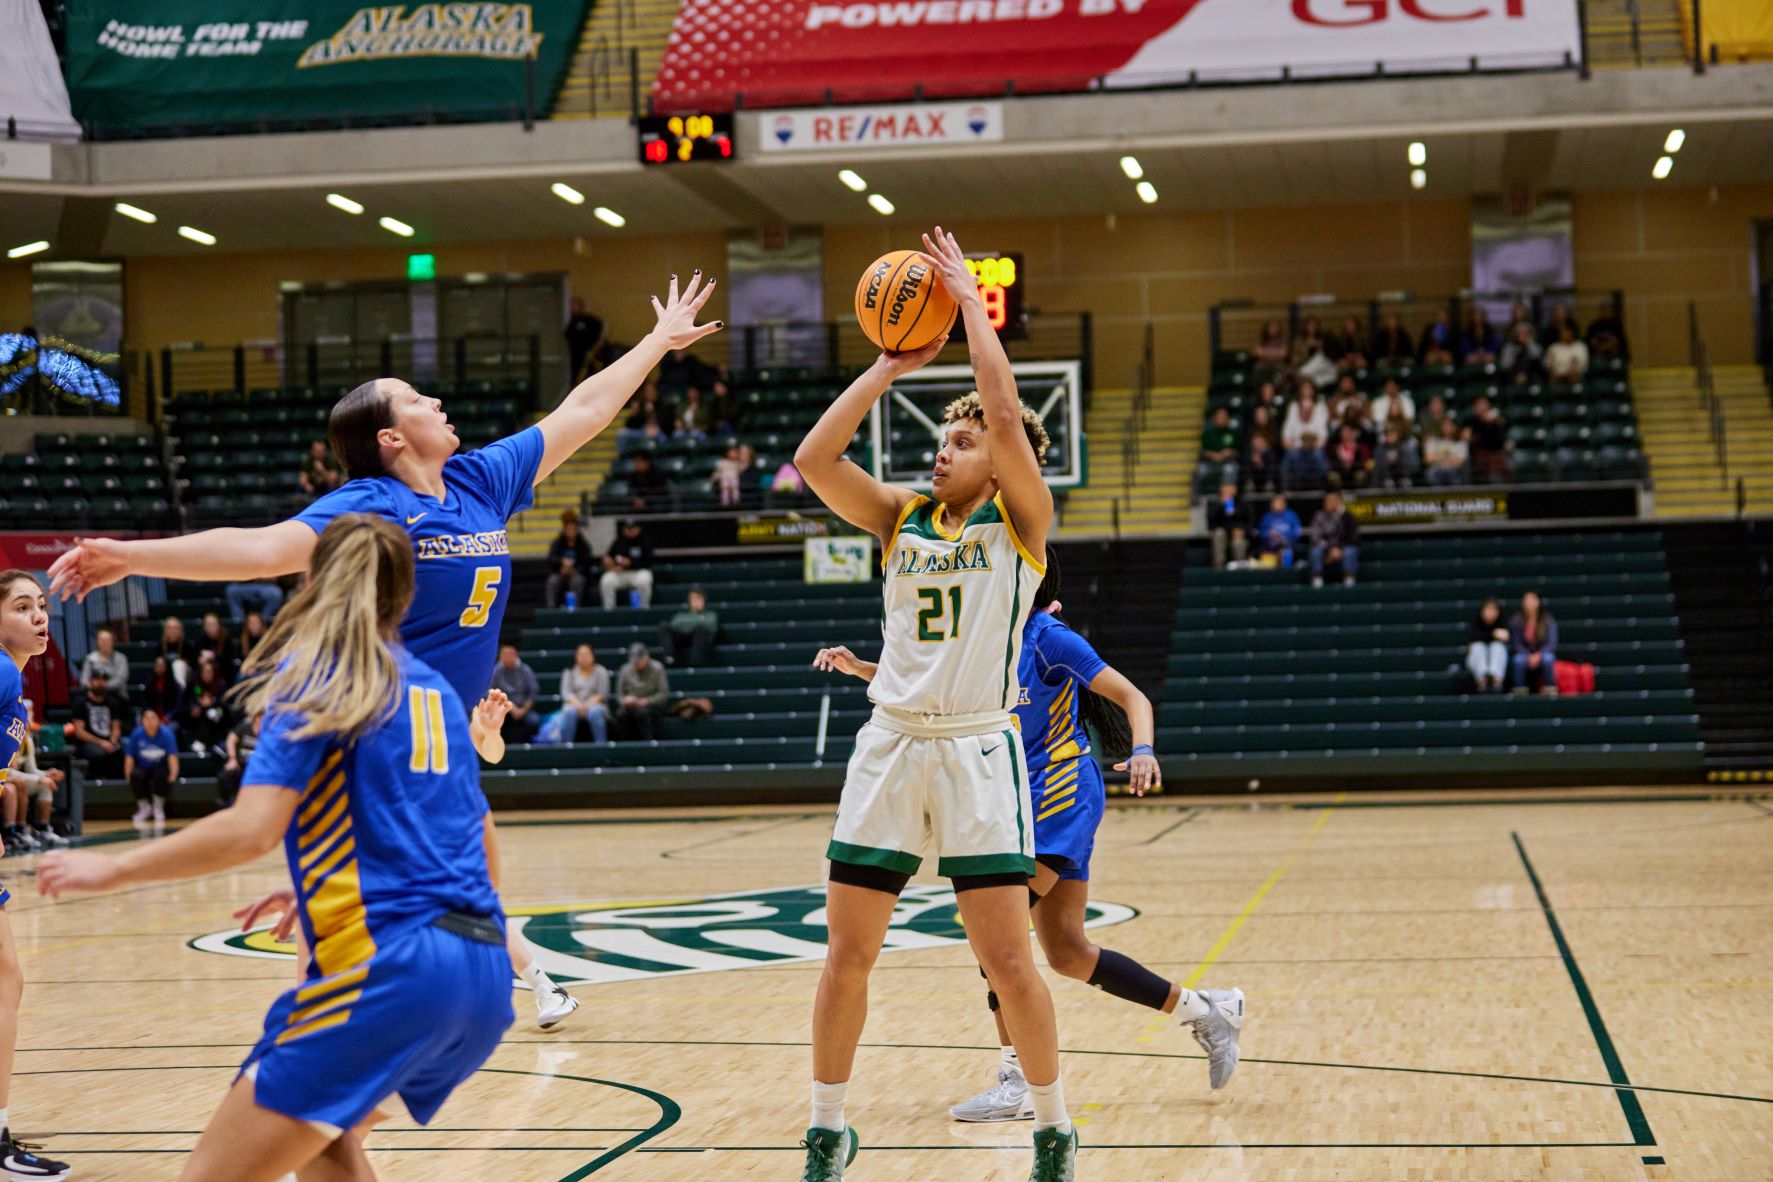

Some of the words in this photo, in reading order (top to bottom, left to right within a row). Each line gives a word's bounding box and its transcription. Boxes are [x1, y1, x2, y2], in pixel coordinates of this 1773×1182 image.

[107, 19, 185, 43] HOWL
[193, 23, 250, 42] FOR
[256, 20, 309, 40] THE
[333, 3, 532, 36] ALASKA
[97, 31, 180, 59] HOME
[186, 40, 262, 57] TEAM
[297, 31, 544, 69] ANCHORAGE
[813, 112, 947, 142] RE/MAX
[865, 261, 891, 309] NCAA
[886, 263, 928, 326] Wilson
[1376, 503, 1442, 517] NATIONAL
[1447, 499, 1494, 515] GUARD
[459, 566, 502, 627] 5
[917, 584, 963, 643] 21
[408, 684, 449, 775] 11
